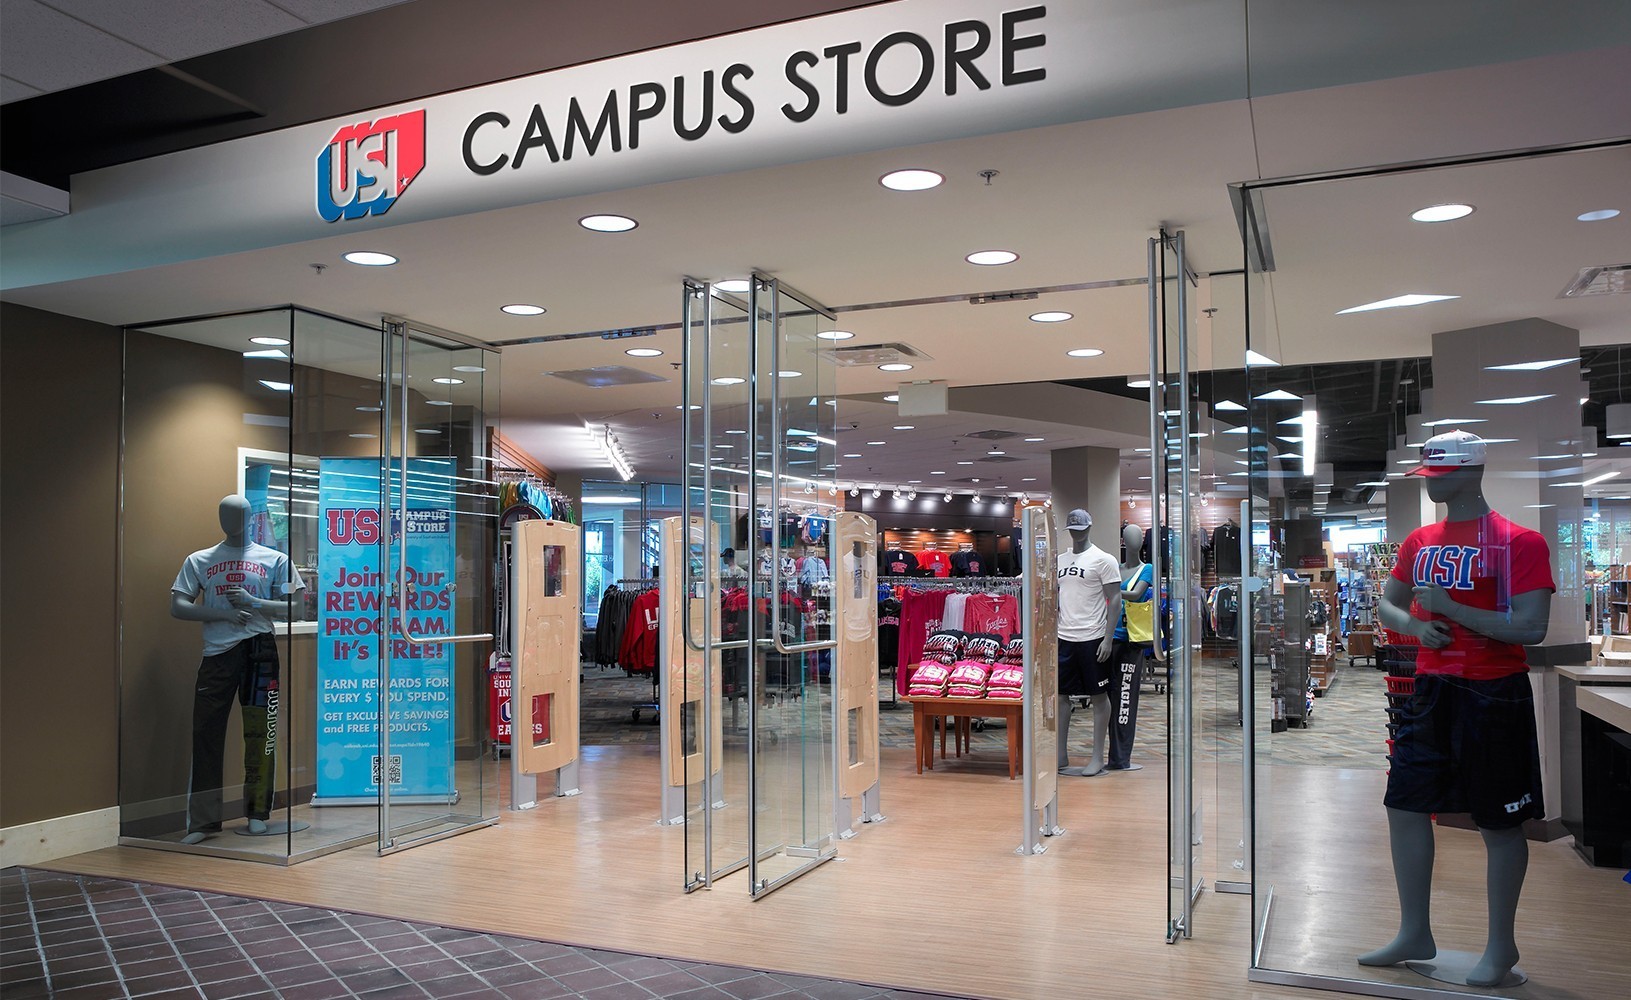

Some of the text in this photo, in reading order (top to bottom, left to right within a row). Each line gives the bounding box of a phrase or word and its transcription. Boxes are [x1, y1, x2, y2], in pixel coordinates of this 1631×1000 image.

[461, 62, 755, 176] CAMPUS
[780, 6, 1047, 123] STORE
[407, 521, 446, 532] STORE
[206, 560, 267, 579] SOUTHERN
[1058, 566, 1085, 579] USI
[1413, 545, 1481, 590] USI
[333, 566, 445, 588] Join Our
[215, 584, 257, 596] INNA
[326, 590, 451, 611] REWARDS
[325, 617, 450, 636] PROGRAM.
[333, 640, 370, 660] It's
[1121, 663, 1136, 673] USI
[324, 679, 358, 690] EARN
[425, 677, 450, 688] FOR
[324, 693, 361, 704] EVERY
[365, 692, 372, 703] $
[407, 691, 449, 702] SPEND.
[498, 689, 511, 697] IN
[1118, 673, 1132, 725] EAGLES
[324, 710, 449, 721] GET EXCLUSVE SAVINGS
[324, 724, 344, 733] and
[347, 723, 370, 733] FREE
